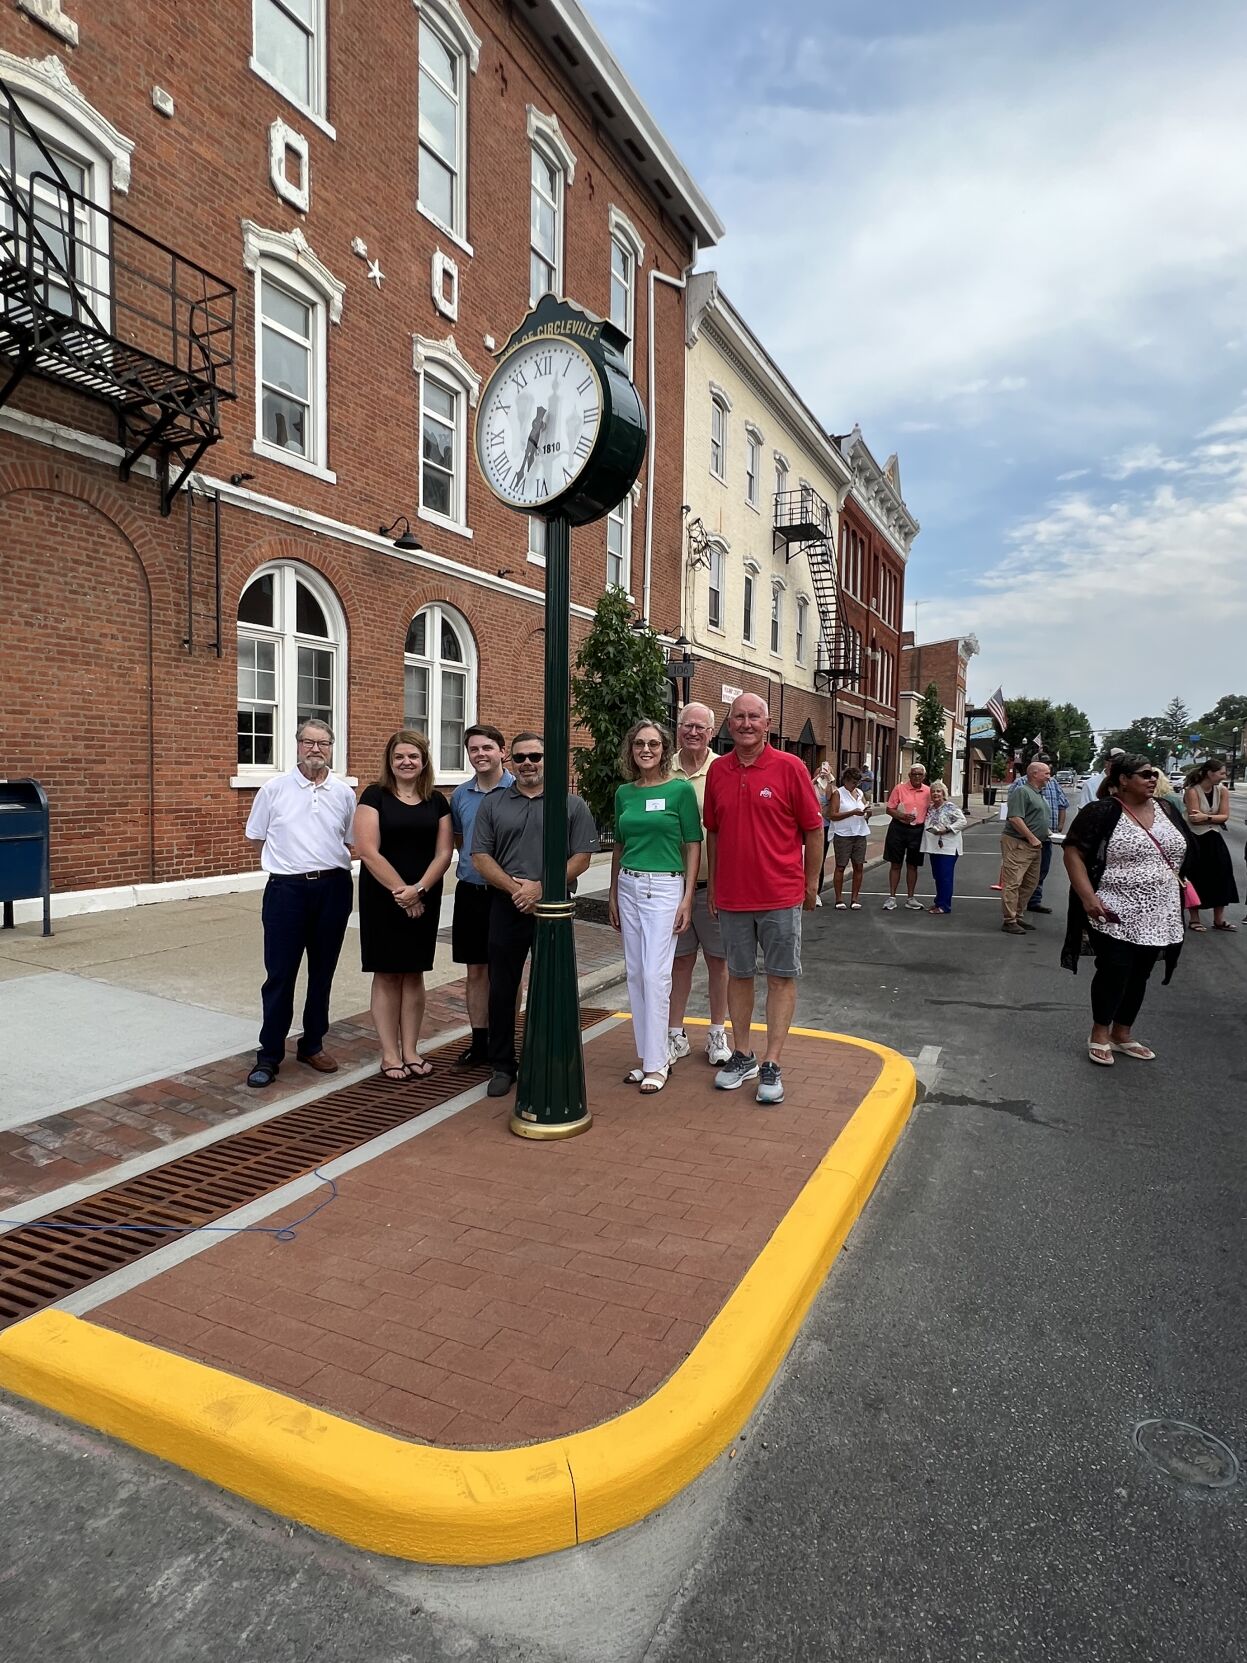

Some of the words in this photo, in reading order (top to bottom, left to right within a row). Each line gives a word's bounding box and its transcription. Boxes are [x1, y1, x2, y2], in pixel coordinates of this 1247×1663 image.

[537, 320, 599, 340] CIRCLEVILLE
[534, 356, 552, 379] XII
[512, 370, 528, 394] XI
[576, 376, 594, 396] II
[496, 400, 511, 416] X
[584, 406, 599, 424] III
[491, 429, 504, 448] IX
[542, 442, 561, 455] 1810
[493, 450, 513, 482] VIII
[536, 478, 549, 498] VI
[673, 665, 689, 675] 106
